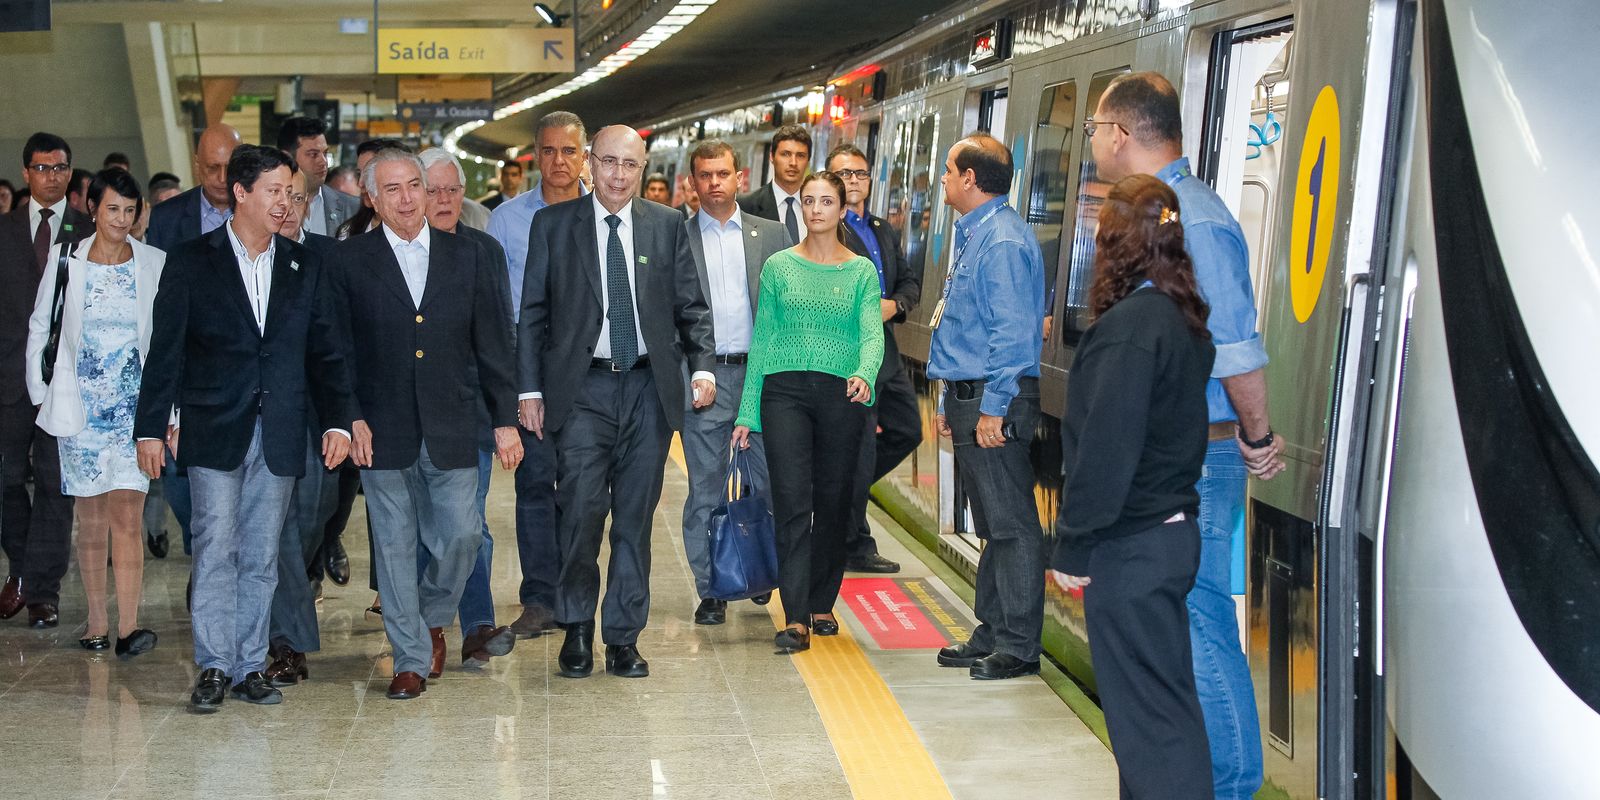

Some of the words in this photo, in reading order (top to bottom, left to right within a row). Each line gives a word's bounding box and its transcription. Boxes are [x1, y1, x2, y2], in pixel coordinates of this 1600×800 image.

[389, 41, 449, 60] Saída
[459, 46, 485, 60] Exit
[1306, 136, 1326, 274] 1
